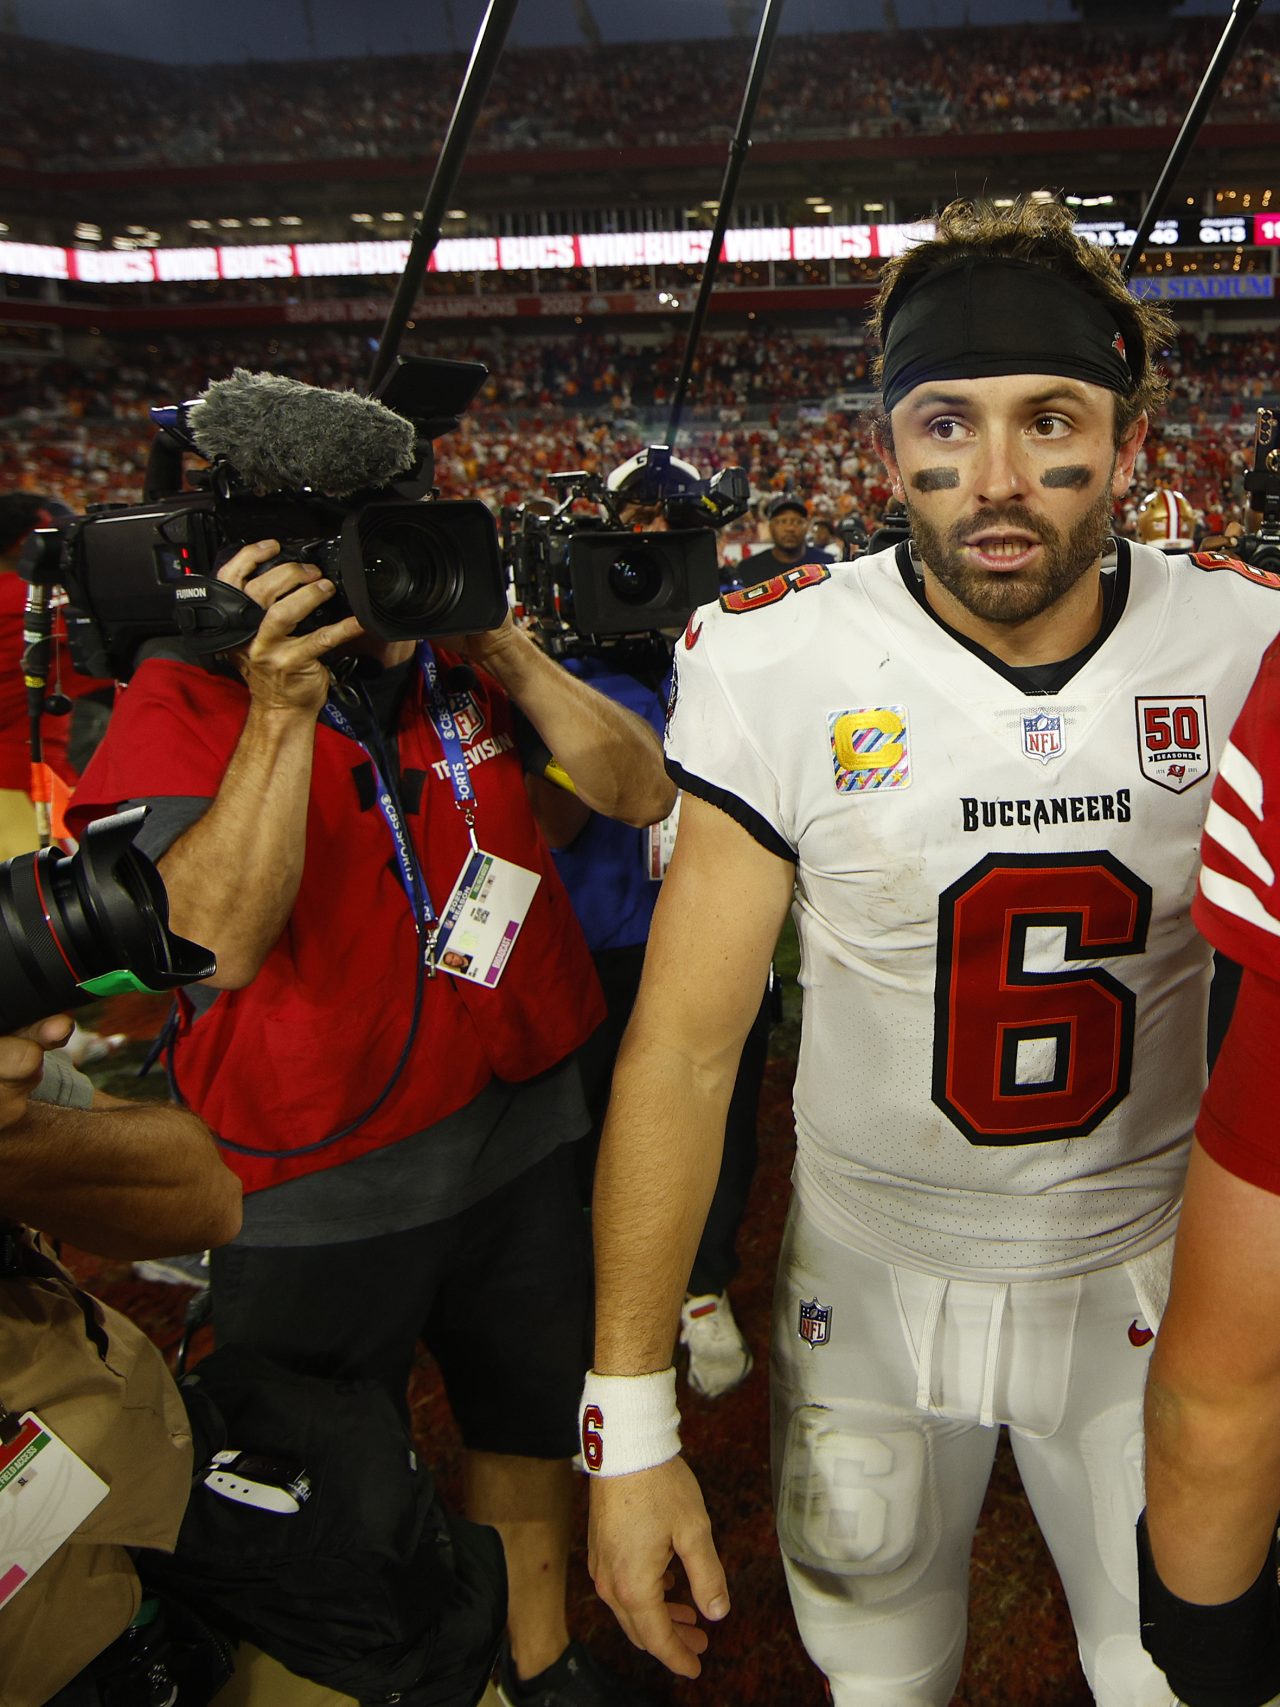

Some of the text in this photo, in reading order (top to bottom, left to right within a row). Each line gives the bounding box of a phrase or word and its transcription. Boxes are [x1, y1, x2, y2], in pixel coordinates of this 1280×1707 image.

[79, 250, 153, 281] BUCS
[220, 247, 292, 277] BUCS
[359, 241, 412, 273] BUC
[437, 239, 496, 270] WIN!
[500, 236, 573, 268] BUCS
[580, 233, 644, 266] WIN!
[725, 229, 791, 262] WIN!
[794, 226, 871, 259] BUCS
[1167, 275, 1270, 298] STADIUM
[176, 587, 207, 600] FUJINON
[438, 709, 454, 731] CBS
[454, 708, 479, 737] FL
[1143, 706, 1201, 752] 50
[833, 709, 904, 772] C
[1028, 732, 1059, 754] NFL
[1155, 752, 1194, 761] SEASONS
[385, 804, 401, 830] CBS
[452, 885, 472, 921] SEASON
[931, 850, 1153, 1147] 6
[802, 1318, 824, 1341] NFL
[582, 1404, 604, 1471] 6
[15, 1445, 38, 1472] ACCESS
